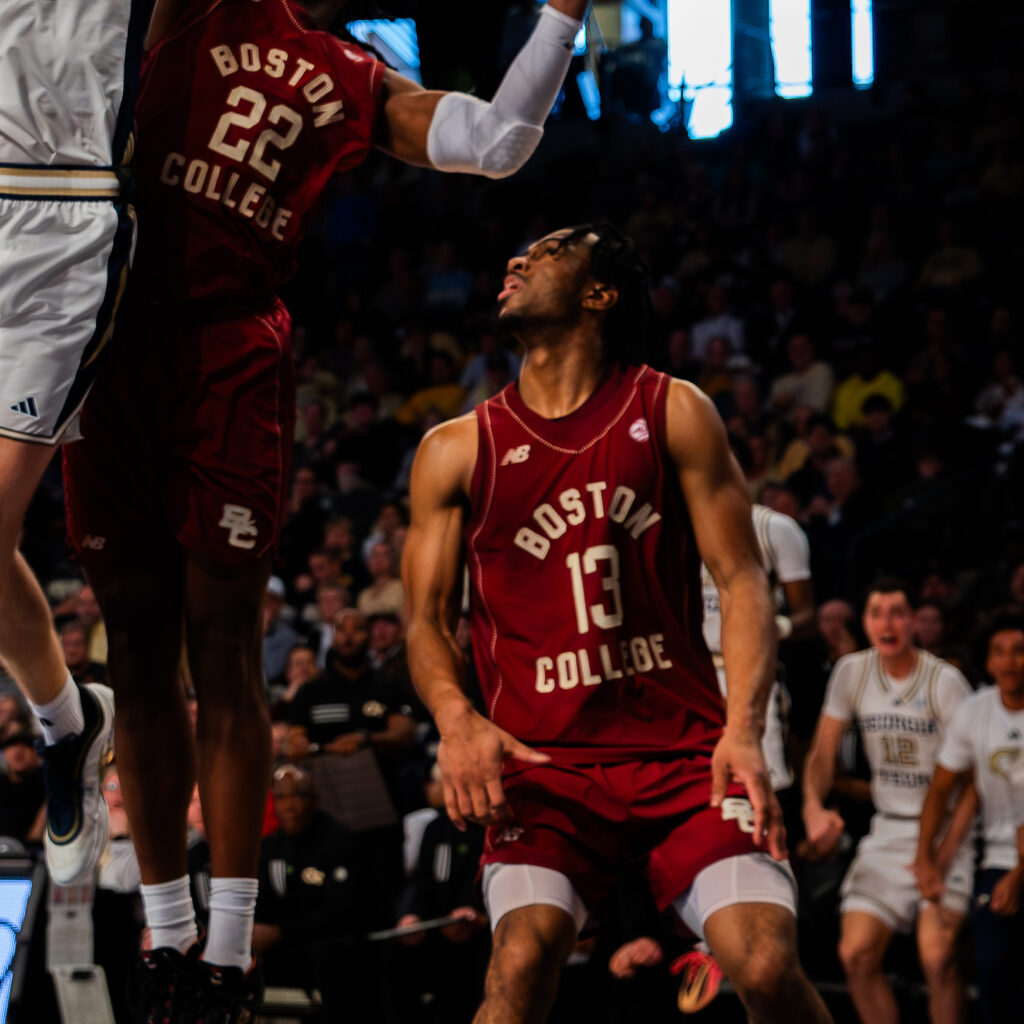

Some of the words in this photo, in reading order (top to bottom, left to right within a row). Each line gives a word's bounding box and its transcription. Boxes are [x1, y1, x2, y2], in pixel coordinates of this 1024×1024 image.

[210, 43, 344, 129] BOSTON
[207, 85, 304, 182] 22
[159, 152, 293, 242] COLLEGE
[513, 481, 662, 559] BOSTON
[565, 544, 624, 634] 13
[535, 633, 672, 694] COLLEGE
[881, 736, 918, 765] 12
